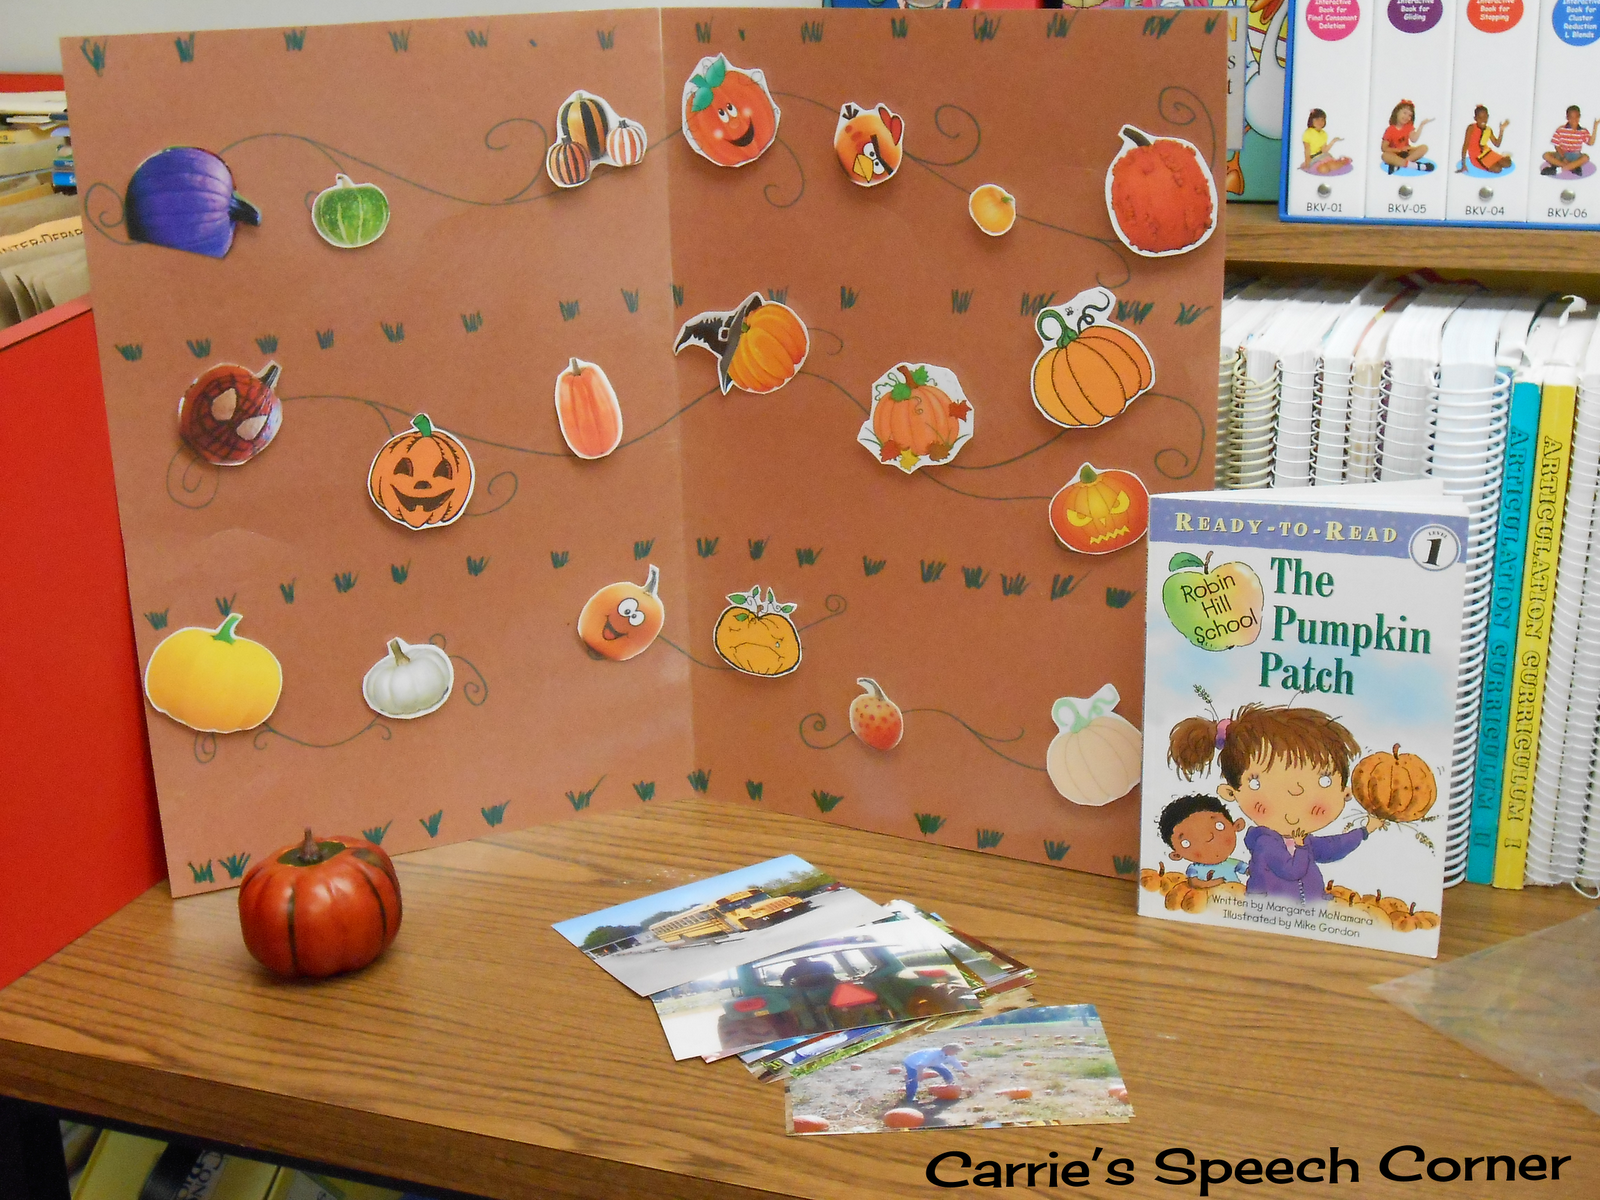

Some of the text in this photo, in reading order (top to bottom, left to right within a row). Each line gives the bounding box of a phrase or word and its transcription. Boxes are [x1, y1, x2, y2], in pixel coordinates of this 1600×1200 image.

[1401, 5, 1417, 13] Book
[1403, 13, 1426, 22] Gliding
[1480, 13, 1510, 22] Stopping
[1319, 22, 1346, 30] Deletion
[1563, 22, 1598, 30] Reduction
[1565, 30, 1595, 39] L Blends
[1306, 202, 1343, 213] BKV-01
[1387, 203, 1427, 214] BKV-05
[1465, 205, 1505, 216] BKV-04
[1547, 208, 1588, 218] BKV-06
[1428, 530, 1448, 539] LEVEL
[1422, 538, 1442, 567] 1
[1270, 556, 1335, 598] The
[1180, 572, 1237, 604] Robin
[1200, 594, 1233, 619] Hill
[1193, 609, 1258, 645] School
[1272, 604, 1431, 657] Pumpkin
[1473, 426, 1530, 848] ARTICULATION CURRICULUM II
[1504, 436, 1563, 849] ARTICULATION CURRICULUM I
[1258, 650, 1355, 695] Patch
[1212, 894, 1374, 926] Written by Margaret McNamara
[1223, 909, 1360, 938] Illustrated by Mike Gordon
